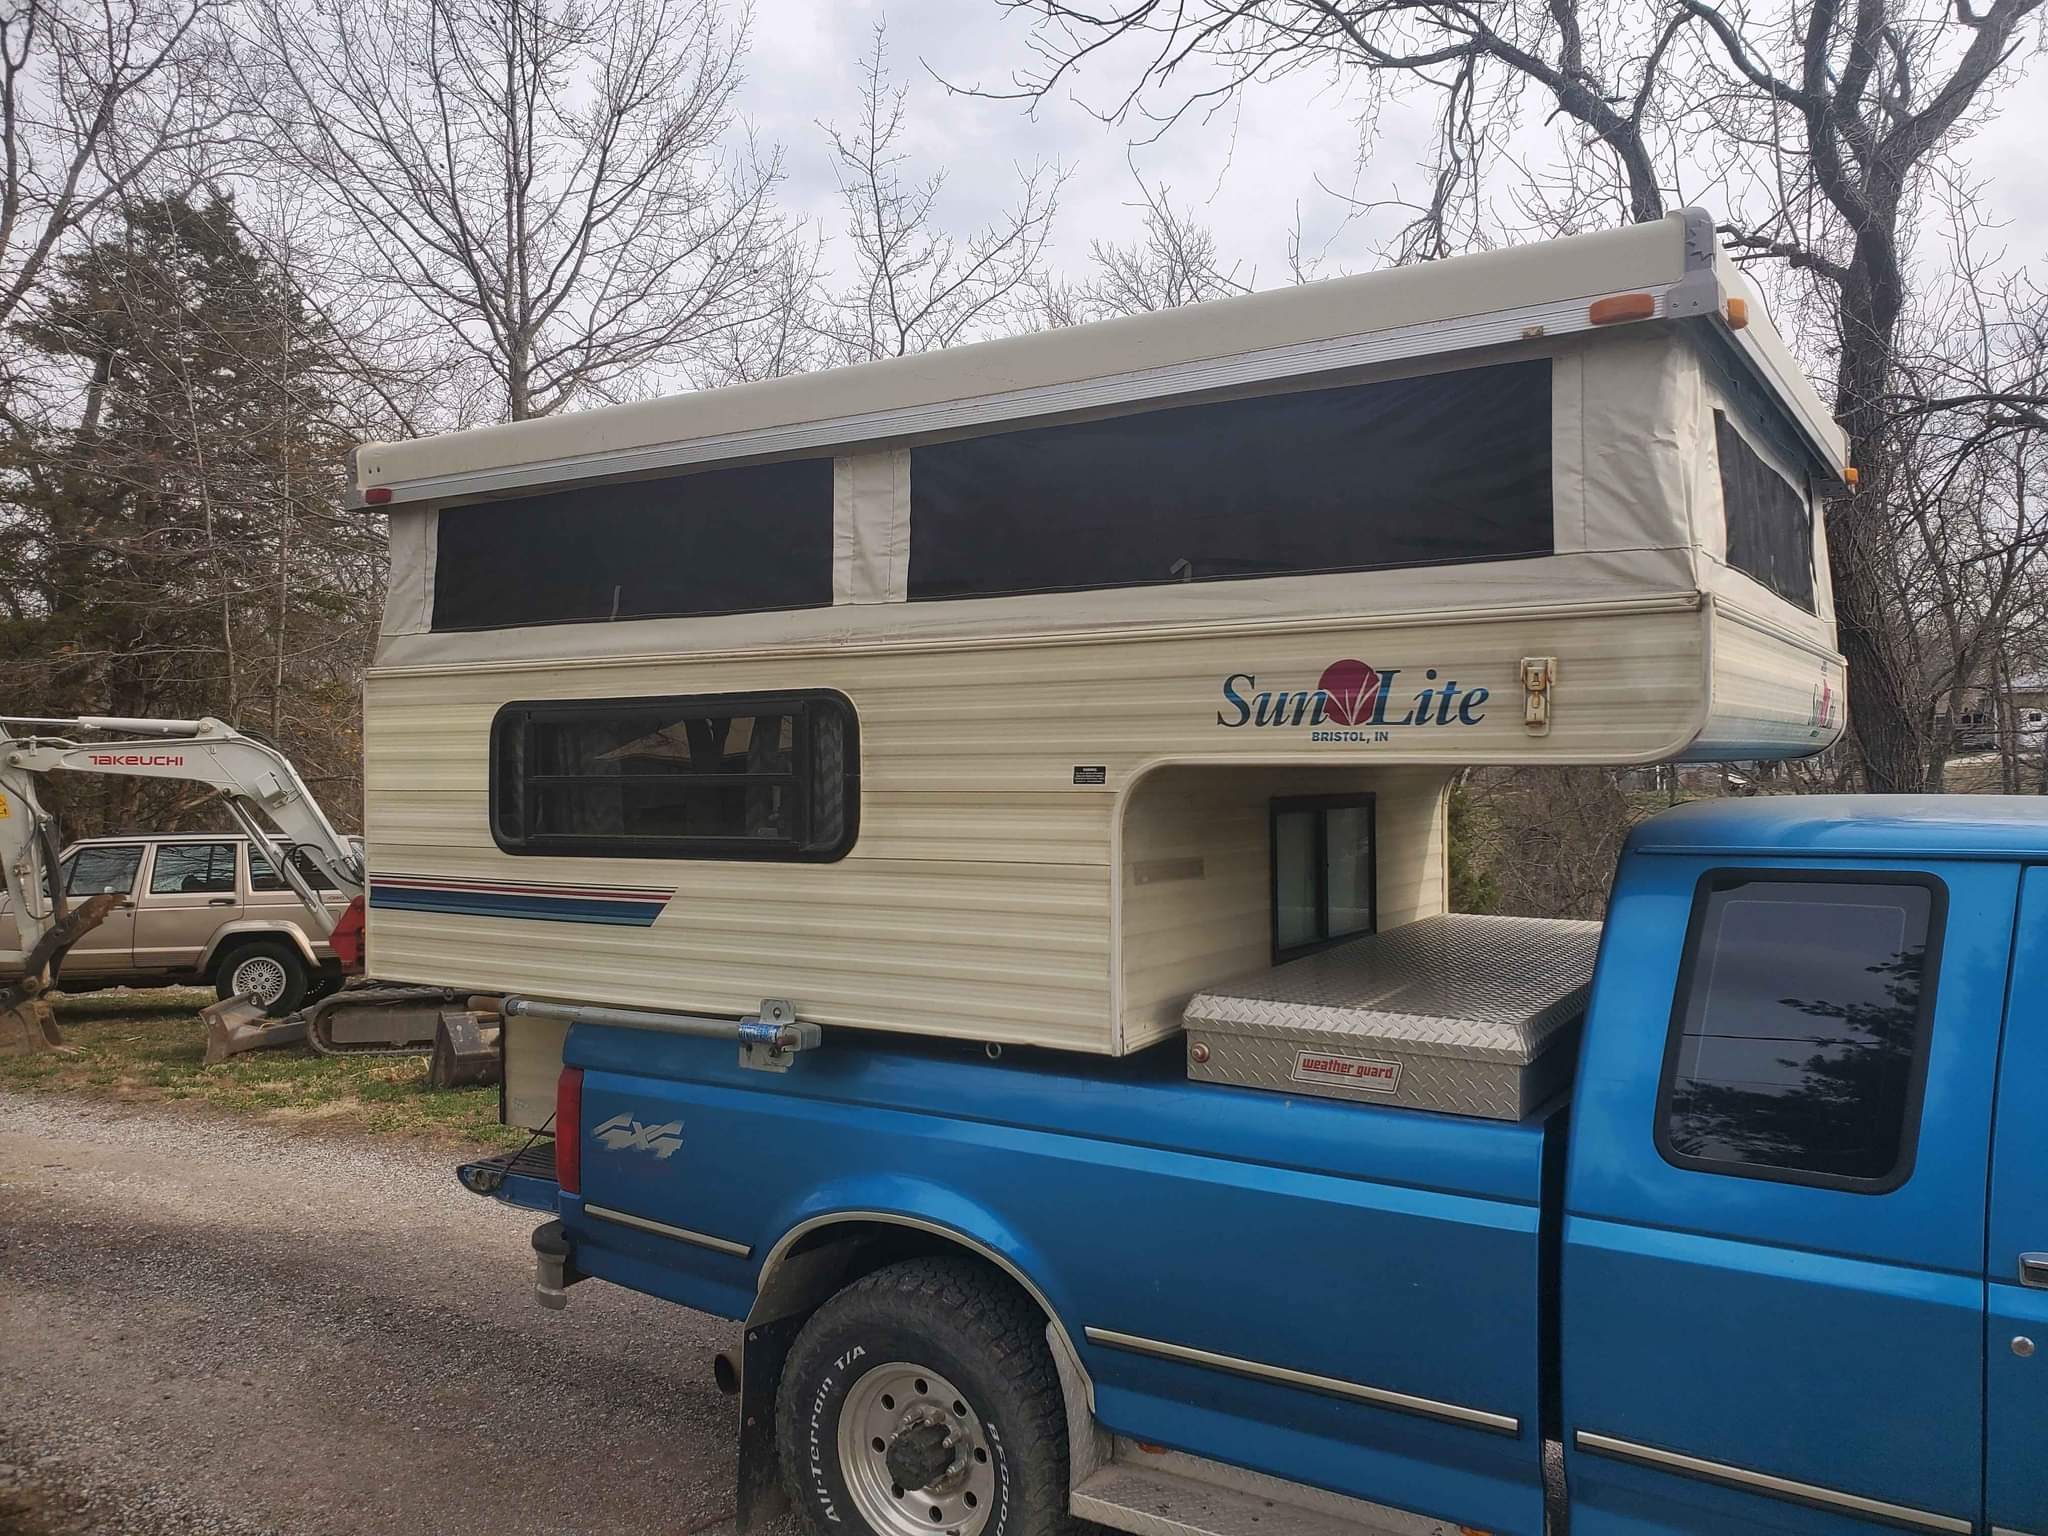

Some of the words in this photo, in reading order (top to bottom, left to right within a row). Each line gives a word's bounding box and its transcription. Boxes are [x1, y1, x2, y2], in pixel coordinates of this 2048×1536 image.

[1217, 673, 1328, 727] Sun
[1366, 669, 1489, 726] Lite
[1312, 731, 1370, 744] BRISTOL,
[1375, 731, 1389, 742] IN
[88, 755, 184, 766] TAKEUCHI
[1302, 1058, 1354, 1073] weather
[1356, 1065, 1393, 1079] guard
[833, 1345, 867, 1371] T/A
